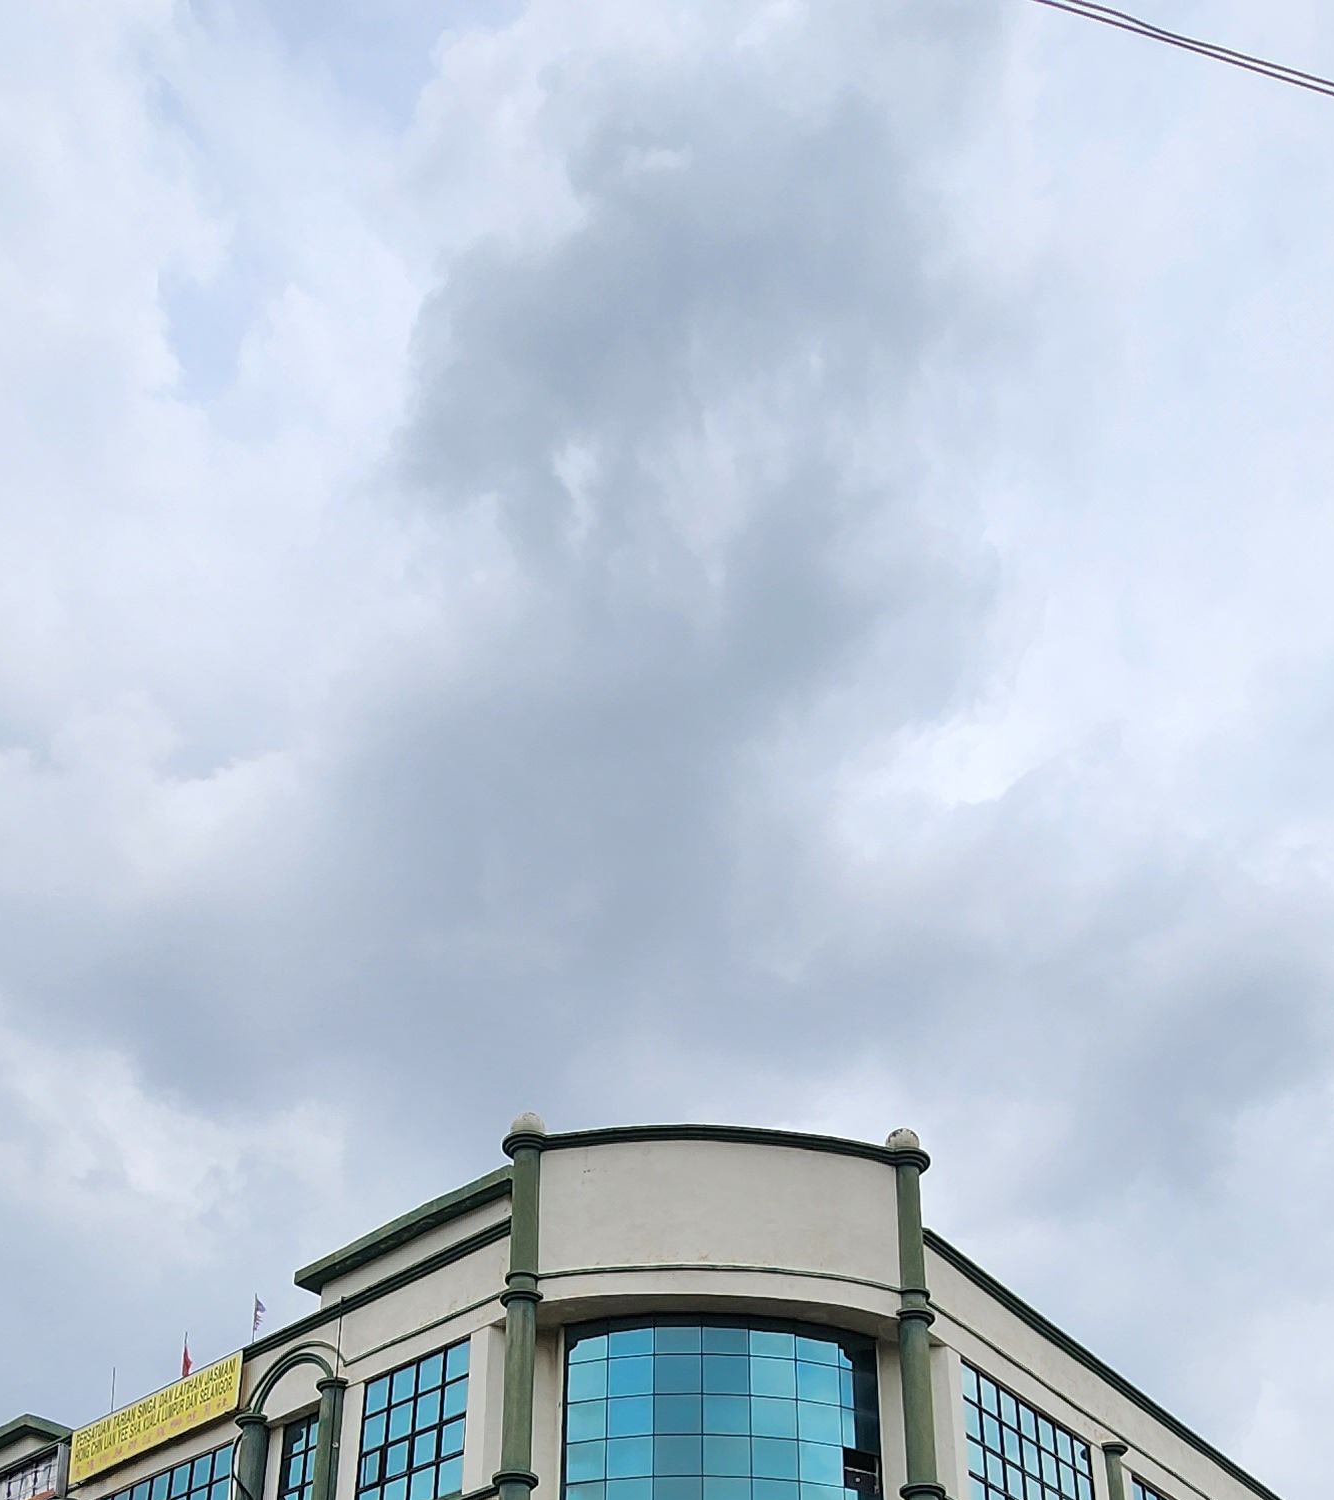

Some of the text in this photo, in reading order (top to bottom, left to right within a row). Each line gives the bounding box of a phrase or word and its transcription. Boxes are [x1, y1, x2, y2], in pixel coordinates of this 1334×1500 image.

[75, 1422, 111, 1448] PERSATUAN
[113, 1409, 135, 1431] TARIAN
[137, 1400, 157, 1420] SINGA
[158, 1390, 174, 1408] DAN
[174, 1378, 203, 1401] LATIHAN
[204, 1357, 237, 1385] JASMANI
[143, 1411, 161, 1433] KUALA
[161, 1400, 185, 1423] LUMPUR
[185, 1393, 199, 1411] DAN
